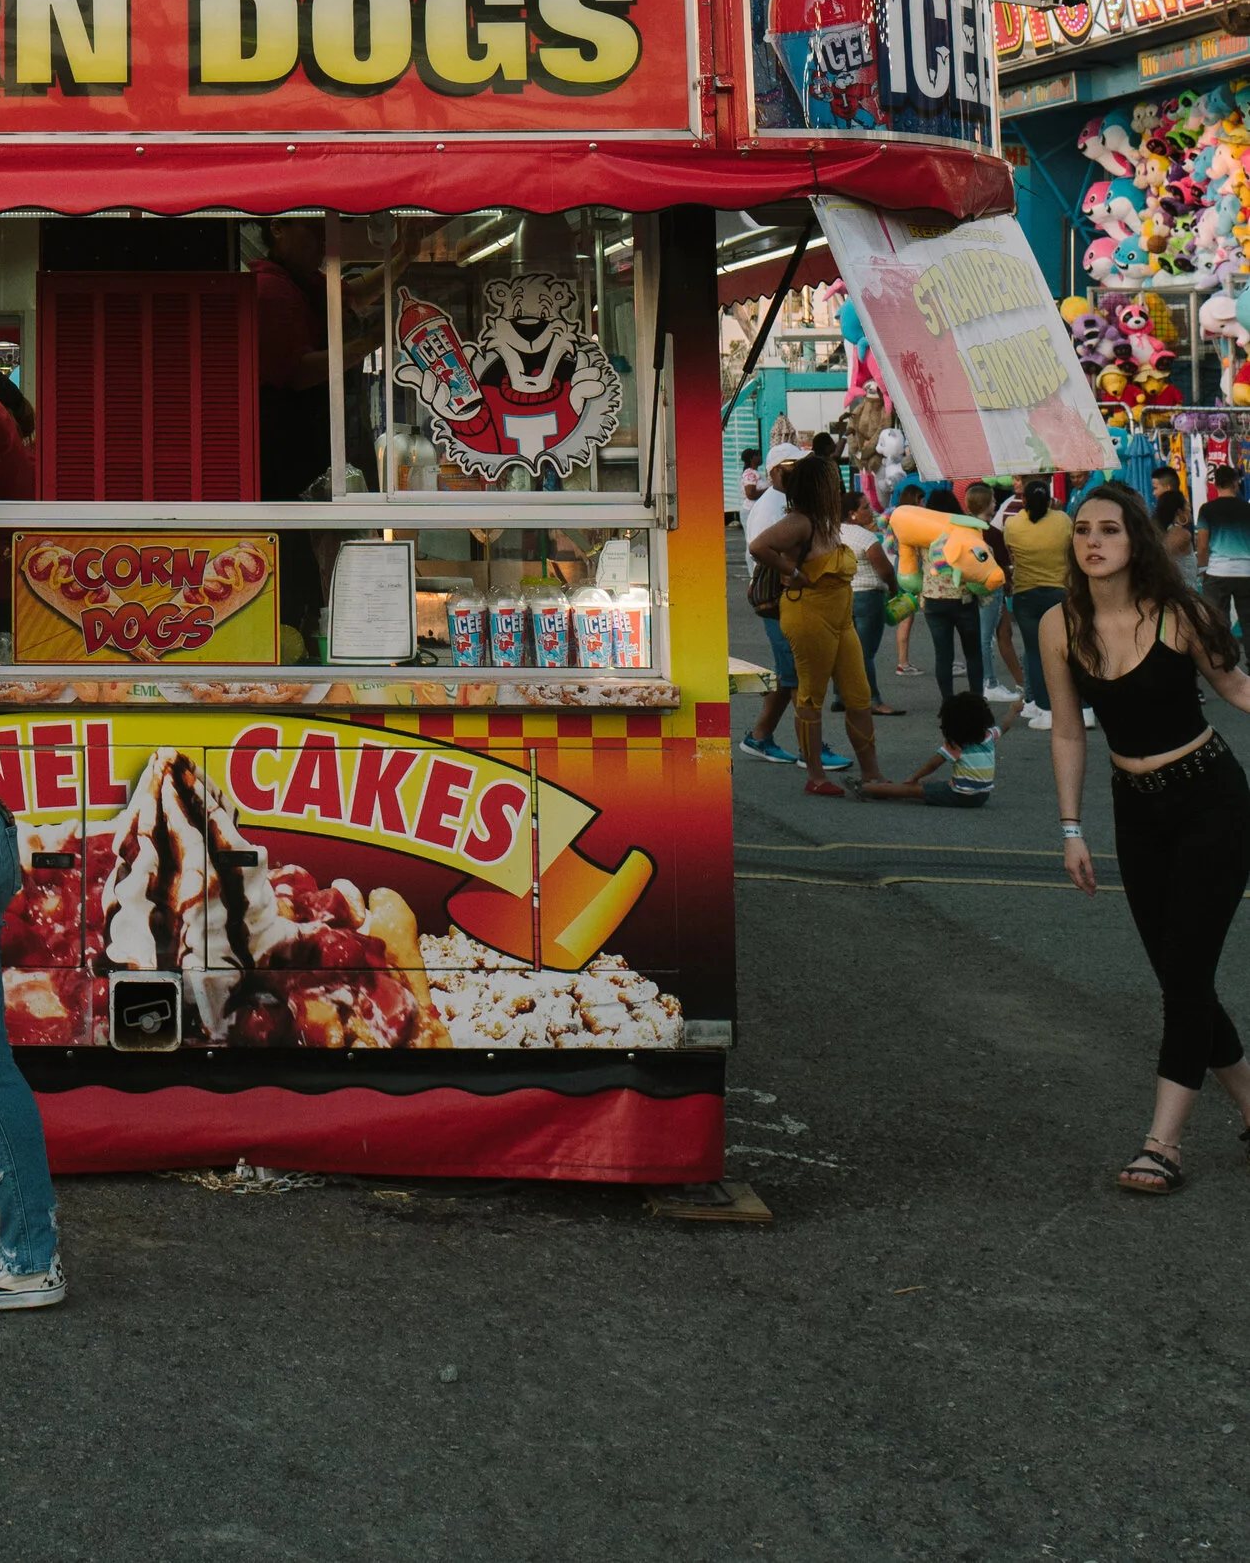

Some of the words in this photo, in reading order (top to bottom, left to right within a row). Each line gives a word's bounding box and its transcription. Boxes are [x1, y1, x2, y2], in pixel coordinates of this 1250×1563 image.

[1142, 55, 1159, 77] BIG
[1201, 37, 1218, 61] BIG
[908, 224, 1006, 243] REFRESHING
[912, 248, 1045, 336] STRAWBERRY
[416, 329, 454, 365] ICEE
[956, 324, 1069, 410] LEMONADE
[72, 544, 209, 589] CORN
[81, 601, 215, 655] DOGS
[454, 613, 482, 635] ICEE
[540, 612, 568, 634] ICEE
[224, 722, 531, 866] CAKES
